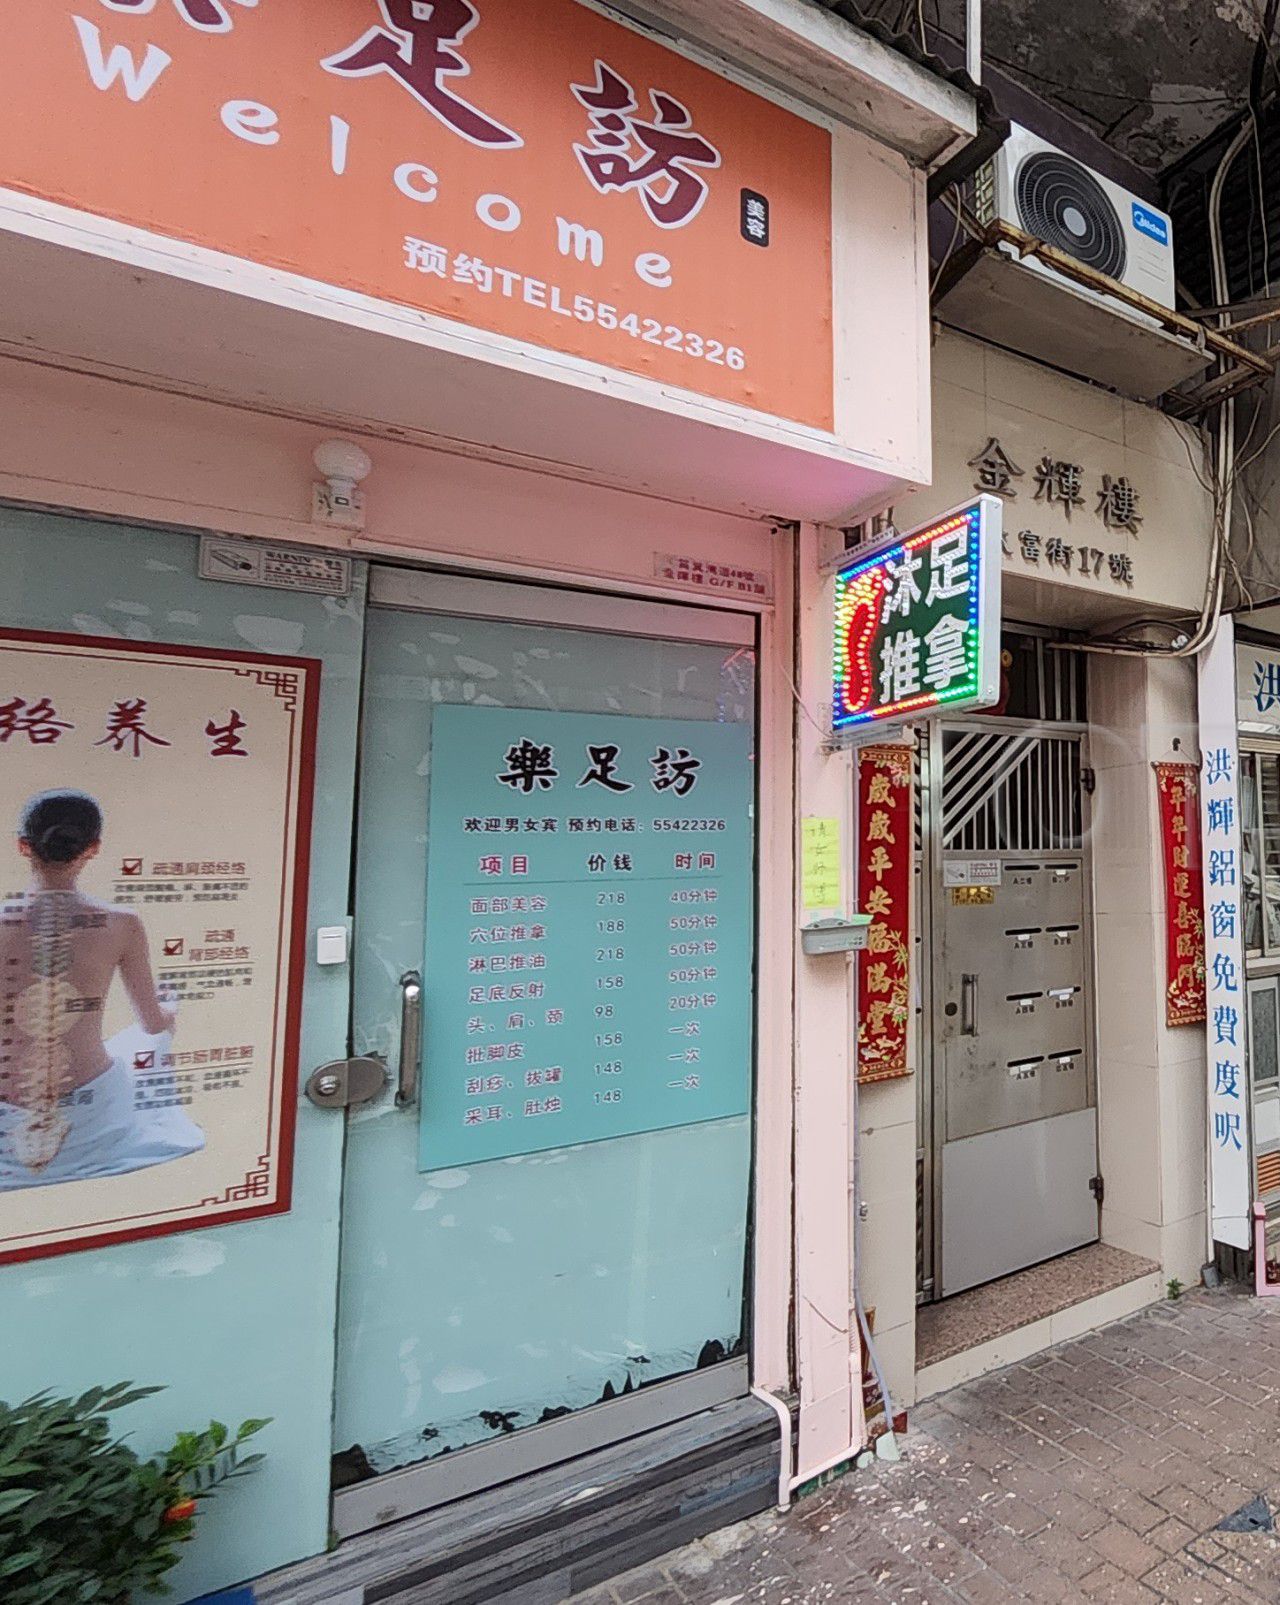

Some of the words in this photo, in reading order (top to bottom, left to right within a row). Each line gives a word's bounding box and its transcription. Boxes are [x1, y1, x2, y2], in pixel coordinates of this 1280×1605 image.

[71, 15, 673, 288] Welcome
[967, 436, 1146, 535] 金輝樓
[880, 524, 972, 624] 沐足
[879, 613, 971, 704] 推拿
[498, 737, 703, 798] 樂足訪
[463, 817, 558, 833] 欢迎男女宾
[653, 818, 726, 832] 55422326
[479, 855, 529, 874] 项目
[588, 853, 633, 872] 价钱
[675, 853, 716, 870] 时间
[471, 896, 548, 914] 面部美容
[598, 892, 625, 905] 218
[671, 889, 718, 903] 40分钟
[470, 924, 547, 943] 穴位推拿
[598, 921, 625, 932] 188
[670, 915, 718, 929] 50分钟
[468, 953, 546, 973] 淋巴推油
[596, 948, 625, 961] 218
[669, 941, 717, 956] 50分钟
[1205, 748, 1243, 1151] 洪輝鋁窗免費度呎
[468, 982, 544, 1003] 足底反射
[597, 976, 624, 989] 158
[669, 967, 717, 982] 50分钟
[594, 1005, 614, 1018] 98
[668, 993, 717, 1010] 20分钟
[595, 1033, 622, 1046] 158
[668, 1021, 700, 1036] 一次
[594, 1061, 622, 1074] 148
[667, 1048, 700, 1063] 一次
[594, 1090, 622, 1103] 148
[667, 1075, 700, 1090] 一次
